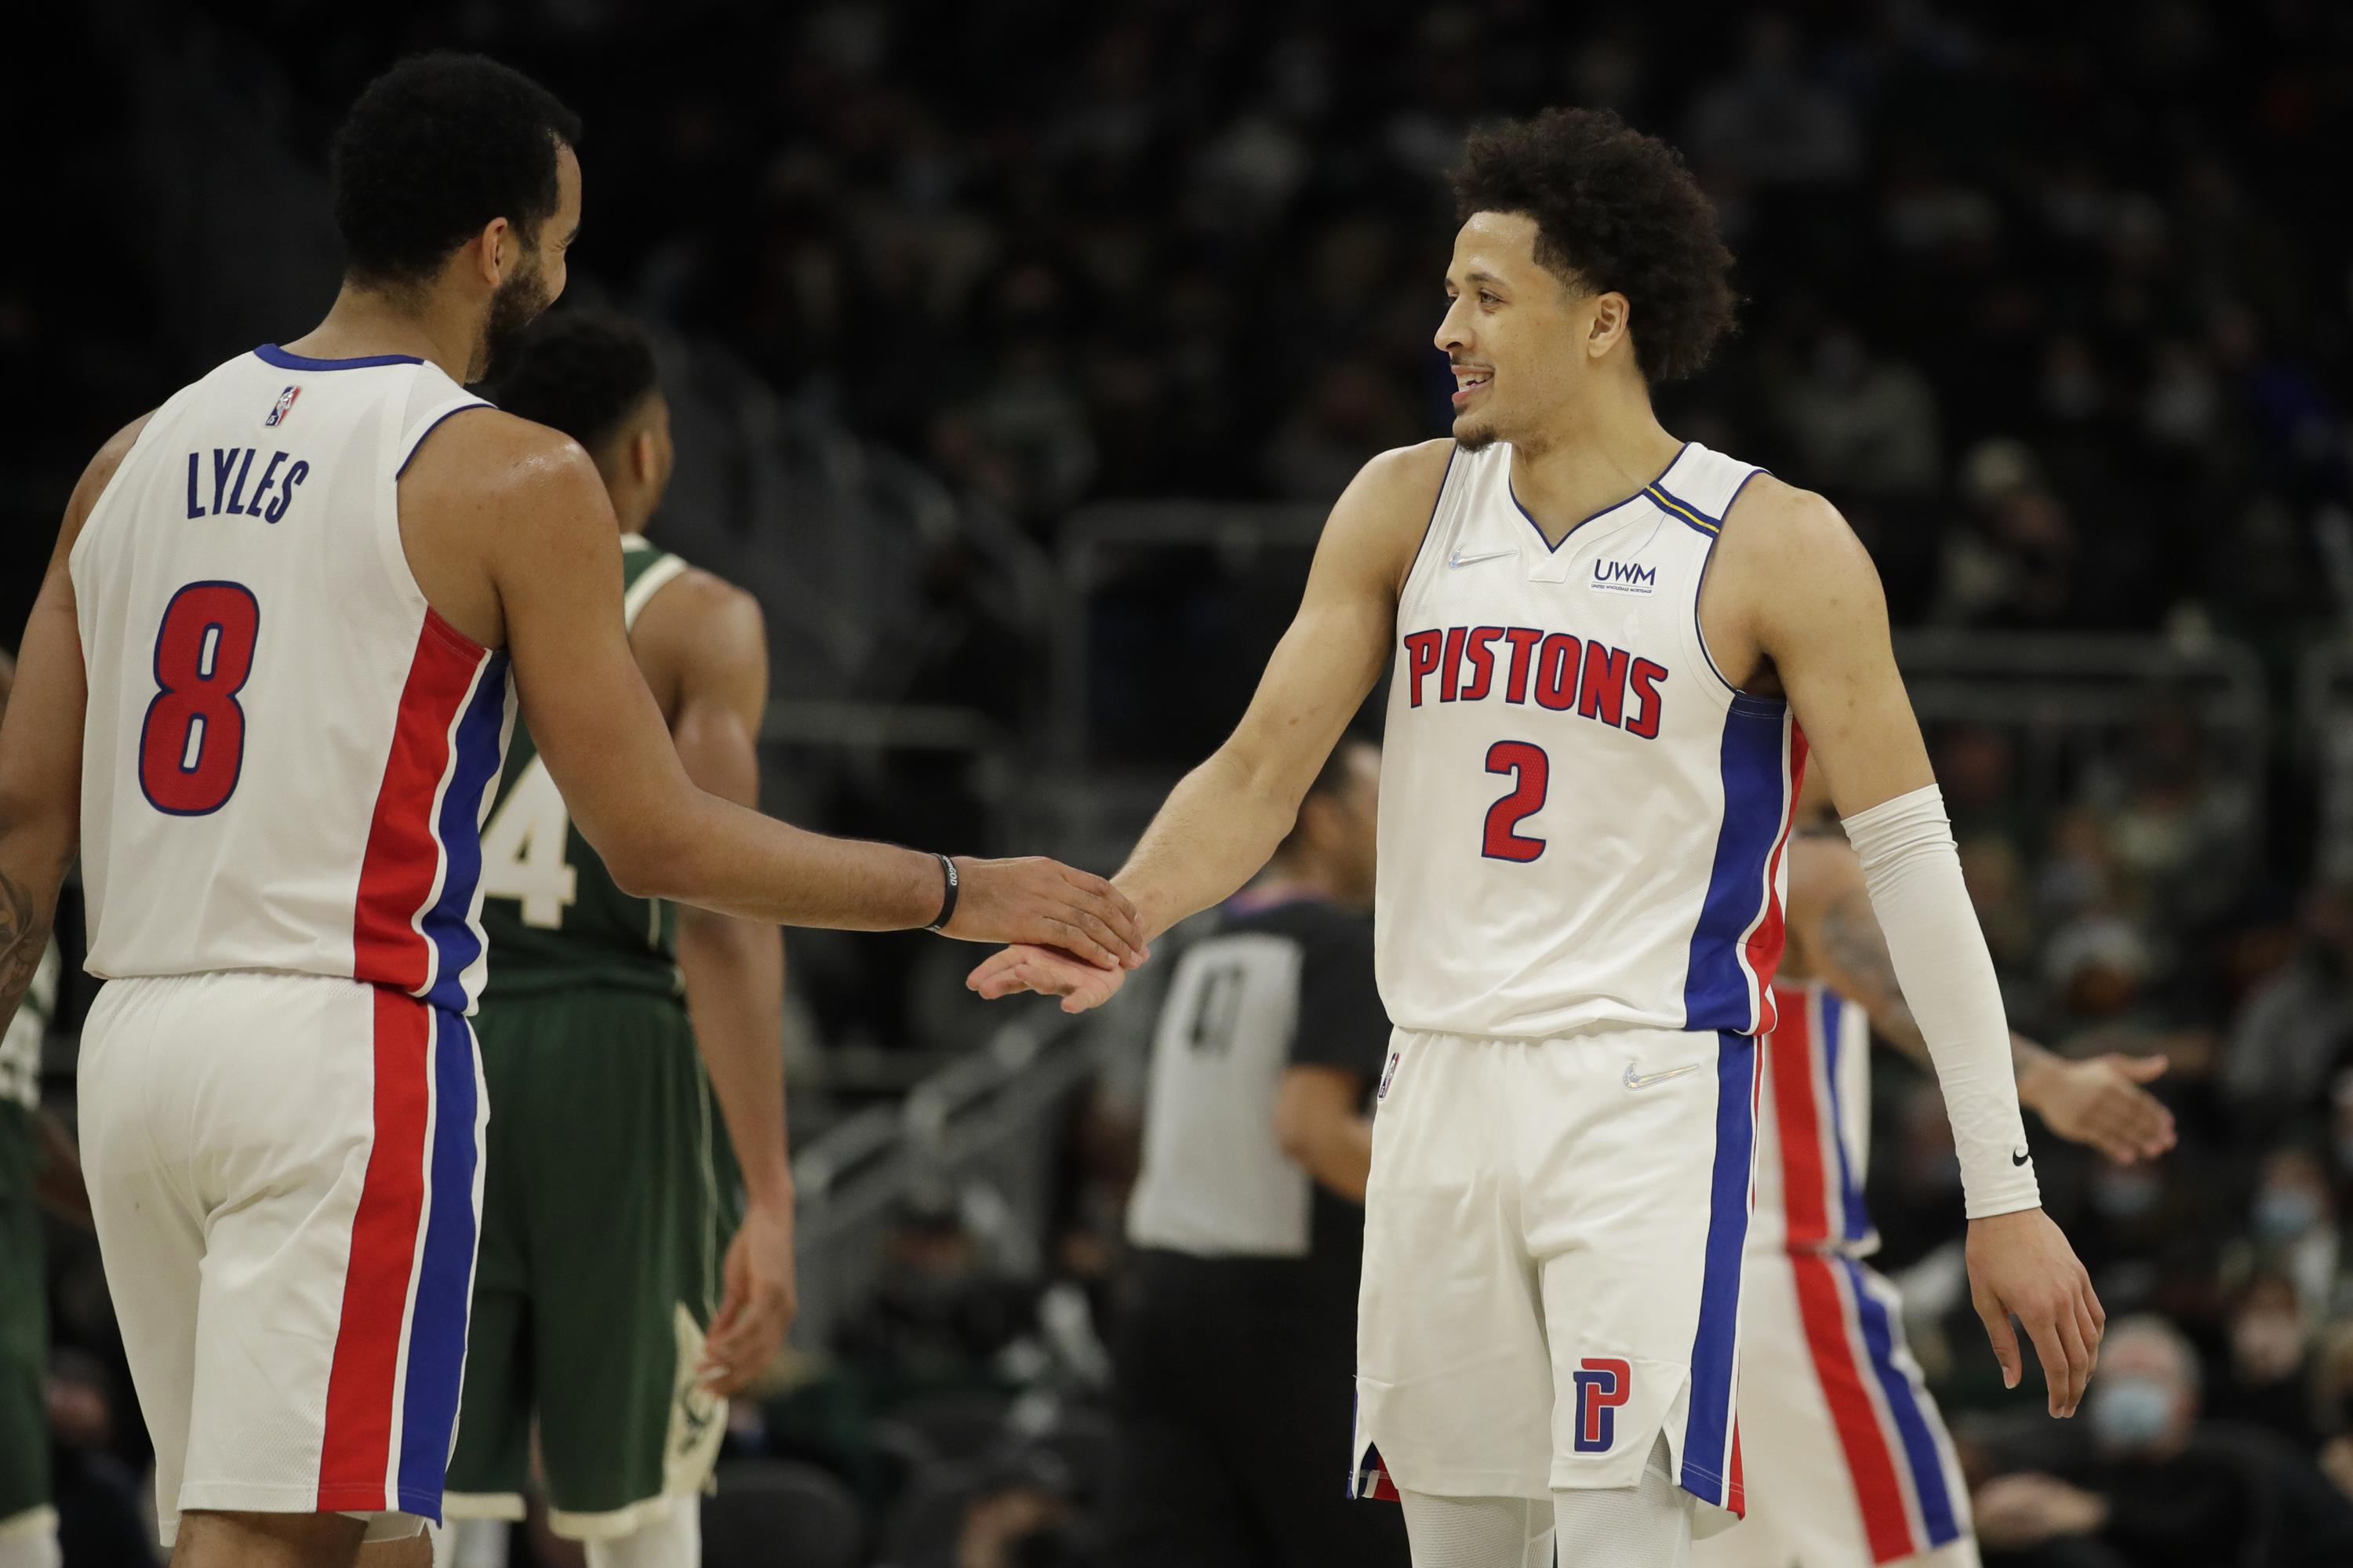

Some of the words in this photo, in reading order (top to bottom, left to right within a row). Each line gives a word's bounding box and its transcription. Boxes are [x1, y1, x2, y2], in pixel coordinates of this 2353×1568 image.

[187, 447, 310, 524] LYLES
[1594, 558, 1657, 586] UWM
[138, 580, 260, 817] 8
[1403, 625, 1668, 740] PISTONS
[1481, 740, 1550, 863] 2
